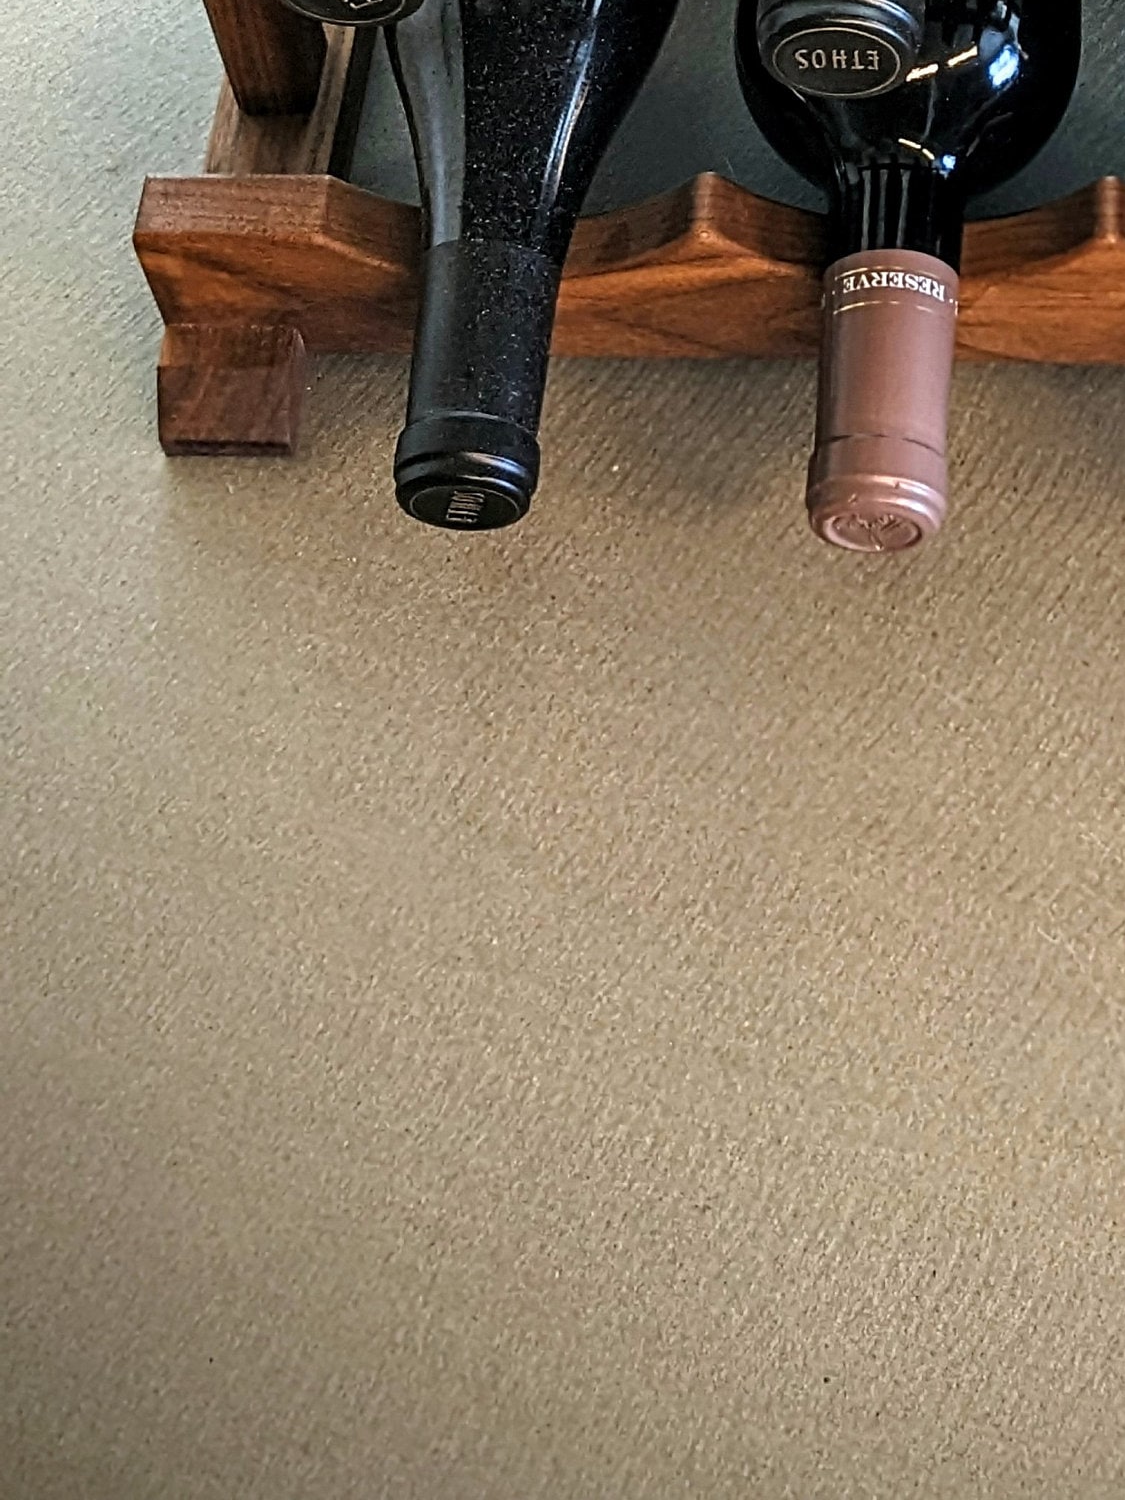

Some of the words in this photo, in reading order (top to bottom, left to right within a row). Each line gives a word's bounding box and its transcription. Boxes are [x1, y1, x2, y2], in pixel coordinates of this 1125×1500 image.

[794, 49, 880, 71] ETHOS
[843, 271, 945, 302] RESERVE
[446, 490, 485, 524] ETHOS
